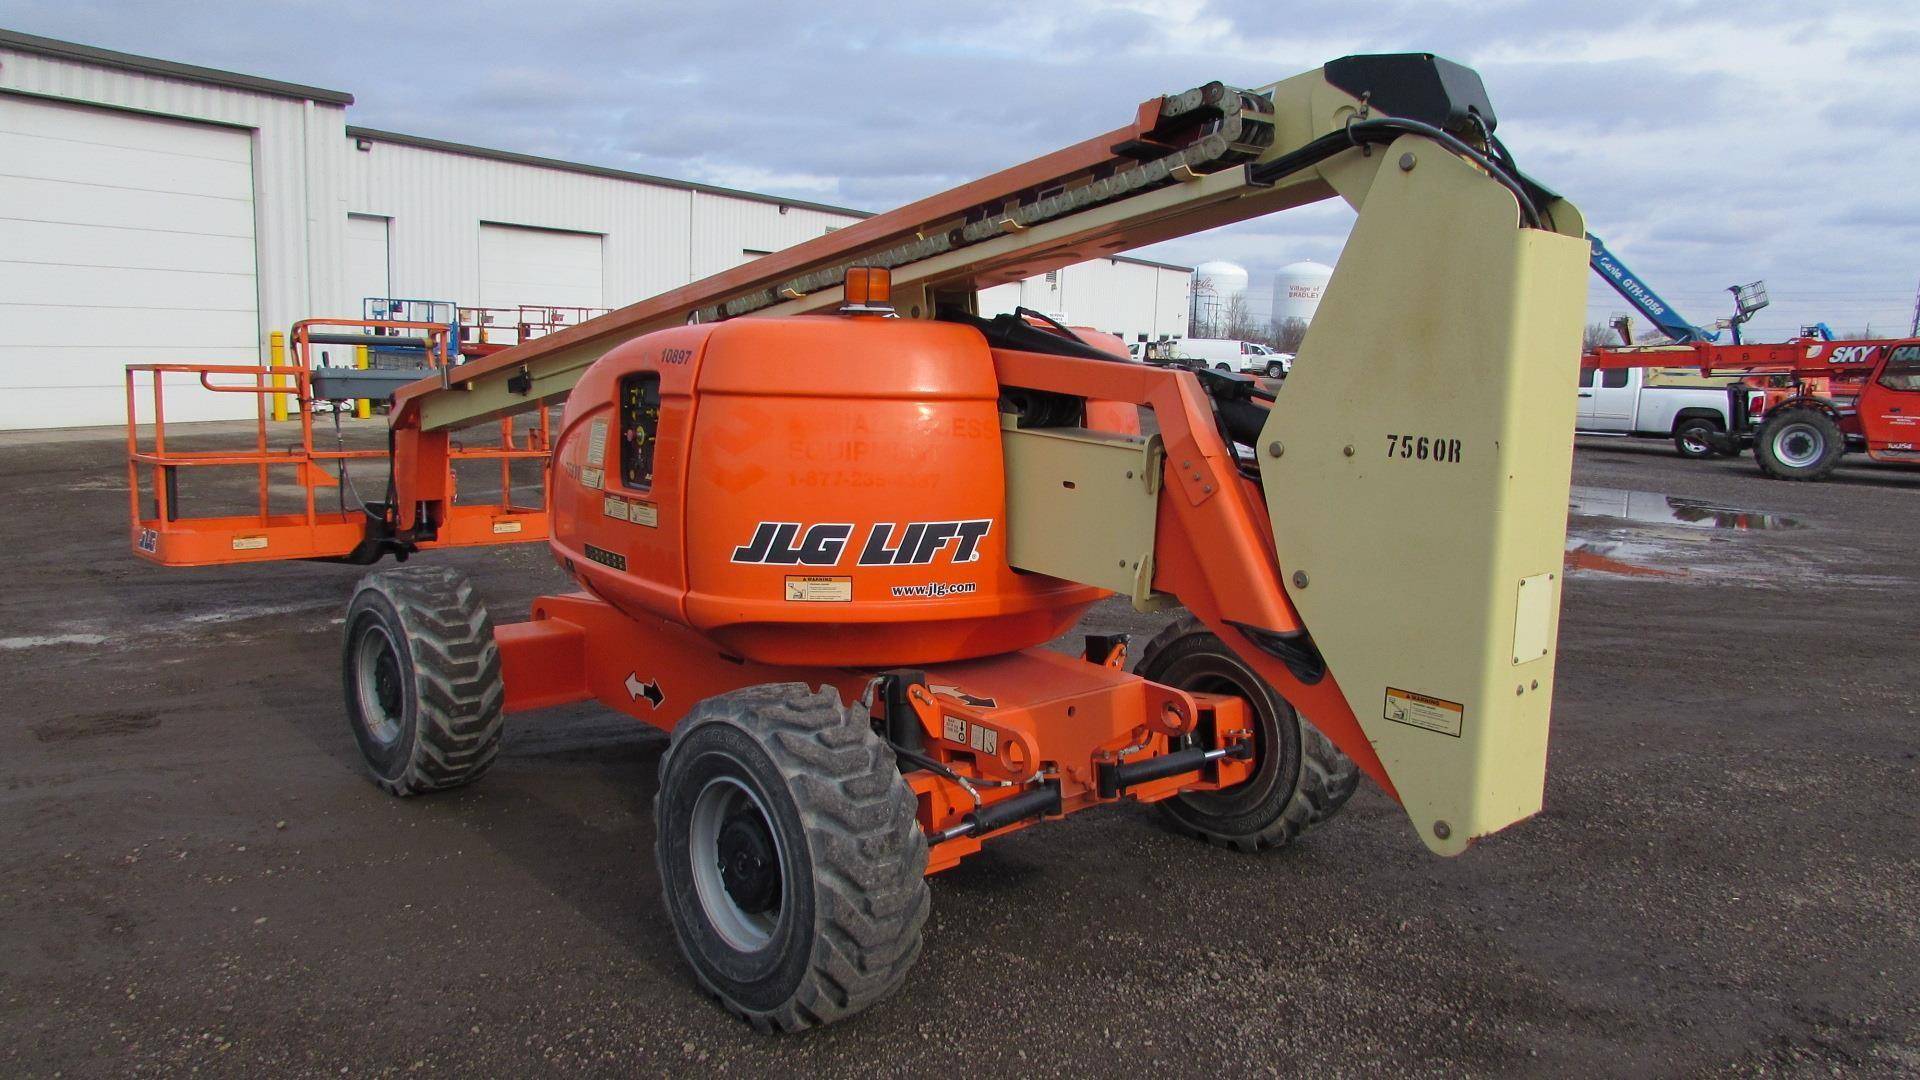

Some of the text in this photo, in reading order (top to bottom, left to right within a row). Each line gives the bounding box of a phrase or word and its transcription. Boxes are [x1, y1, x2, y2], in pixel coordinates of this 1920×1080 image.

[1622, 278, 1664, 315] GTH-1056
[661, 348, 692, 365] 10897
[1387, 435, 1461, 463] 7560R
[731, 519, 993, 566] JLG LIFT
[891, 581, 977, 597] www.jlg.com
[1411, 695, 1440, 706] WARNING
